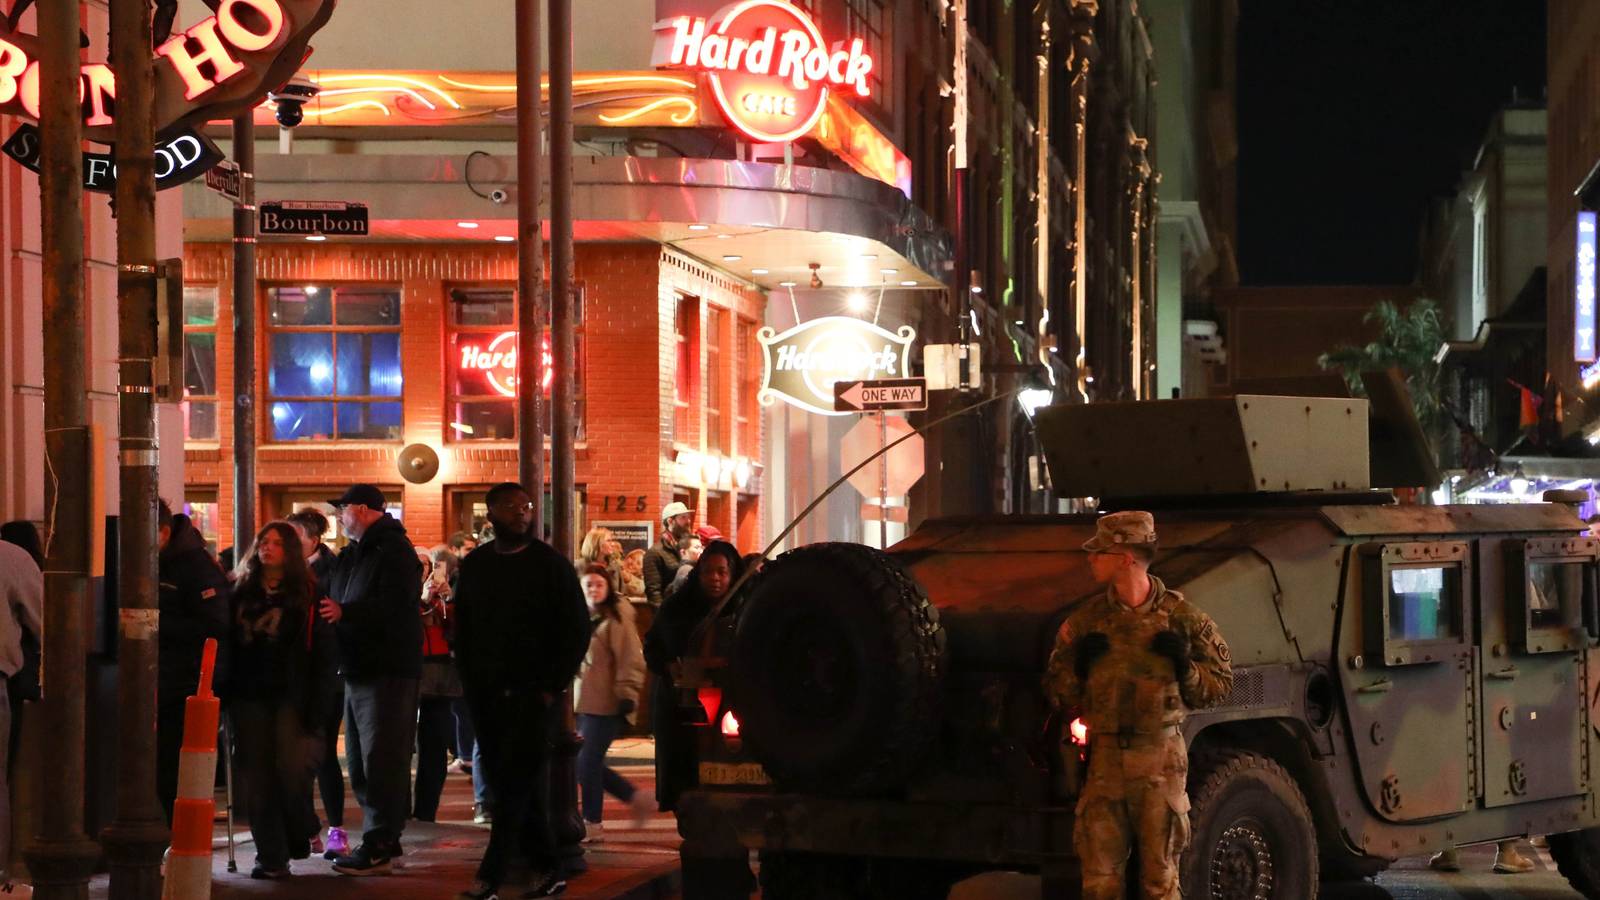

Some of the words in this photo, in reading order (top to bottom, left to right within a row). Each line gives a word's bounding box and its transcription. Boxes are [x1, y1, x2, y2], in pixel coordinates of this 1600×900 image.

[669, 15, 777, 75] Hard
[779, 27, 873, 97] Rock
[741, 92, 797, 117] CAFE
[11, 132, 202, 187] SFOD
[207, 167, 238, 193] Iberville
[263, 212, 365, 231] Bourbon
[461, 345, 517, 369] Hard
[861, 389, 887, 401] ONE
[891, 388, 916, 400] WAY
[603, 495, 647, 511] 125
